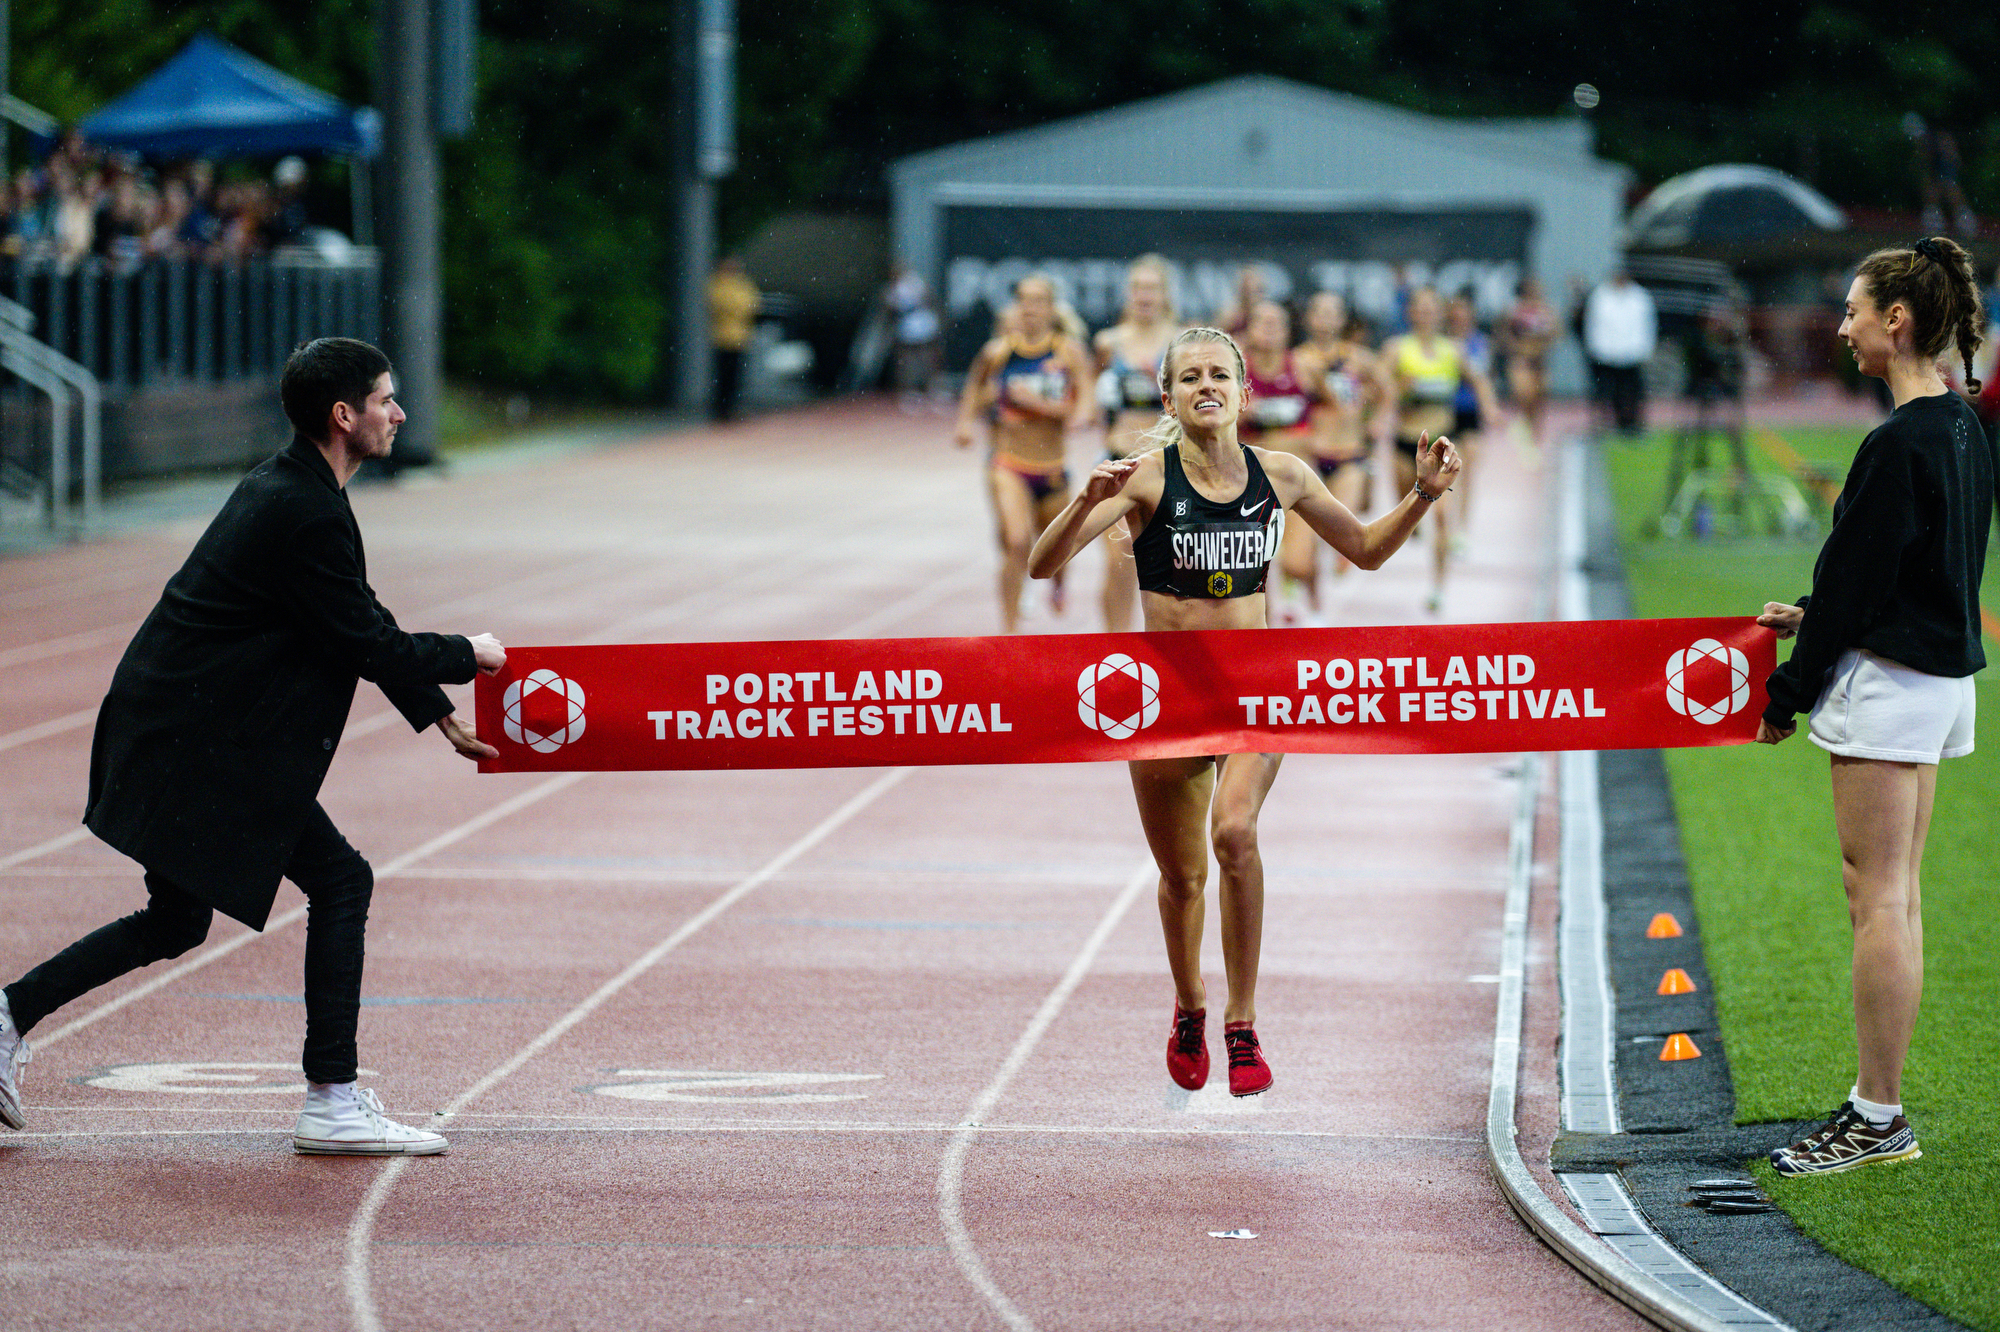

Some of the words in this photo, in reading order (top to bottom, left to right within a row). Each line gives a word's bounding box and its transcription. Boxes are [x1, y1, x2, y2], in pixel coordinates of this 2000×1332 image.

[1172, 530, 1265, 570] SCHWEIZER
[706, 669, 943, 705] PORTLAND
[1297, 654, 1536, 690] PORTLAND
[647, 708, 795, 740] TRACK
[808, 703, 1013, 737] FESTIVAL
[1238, 692, 1386, 726] TRACK
[1399, 688, 1606, 722] FESTIVAL
